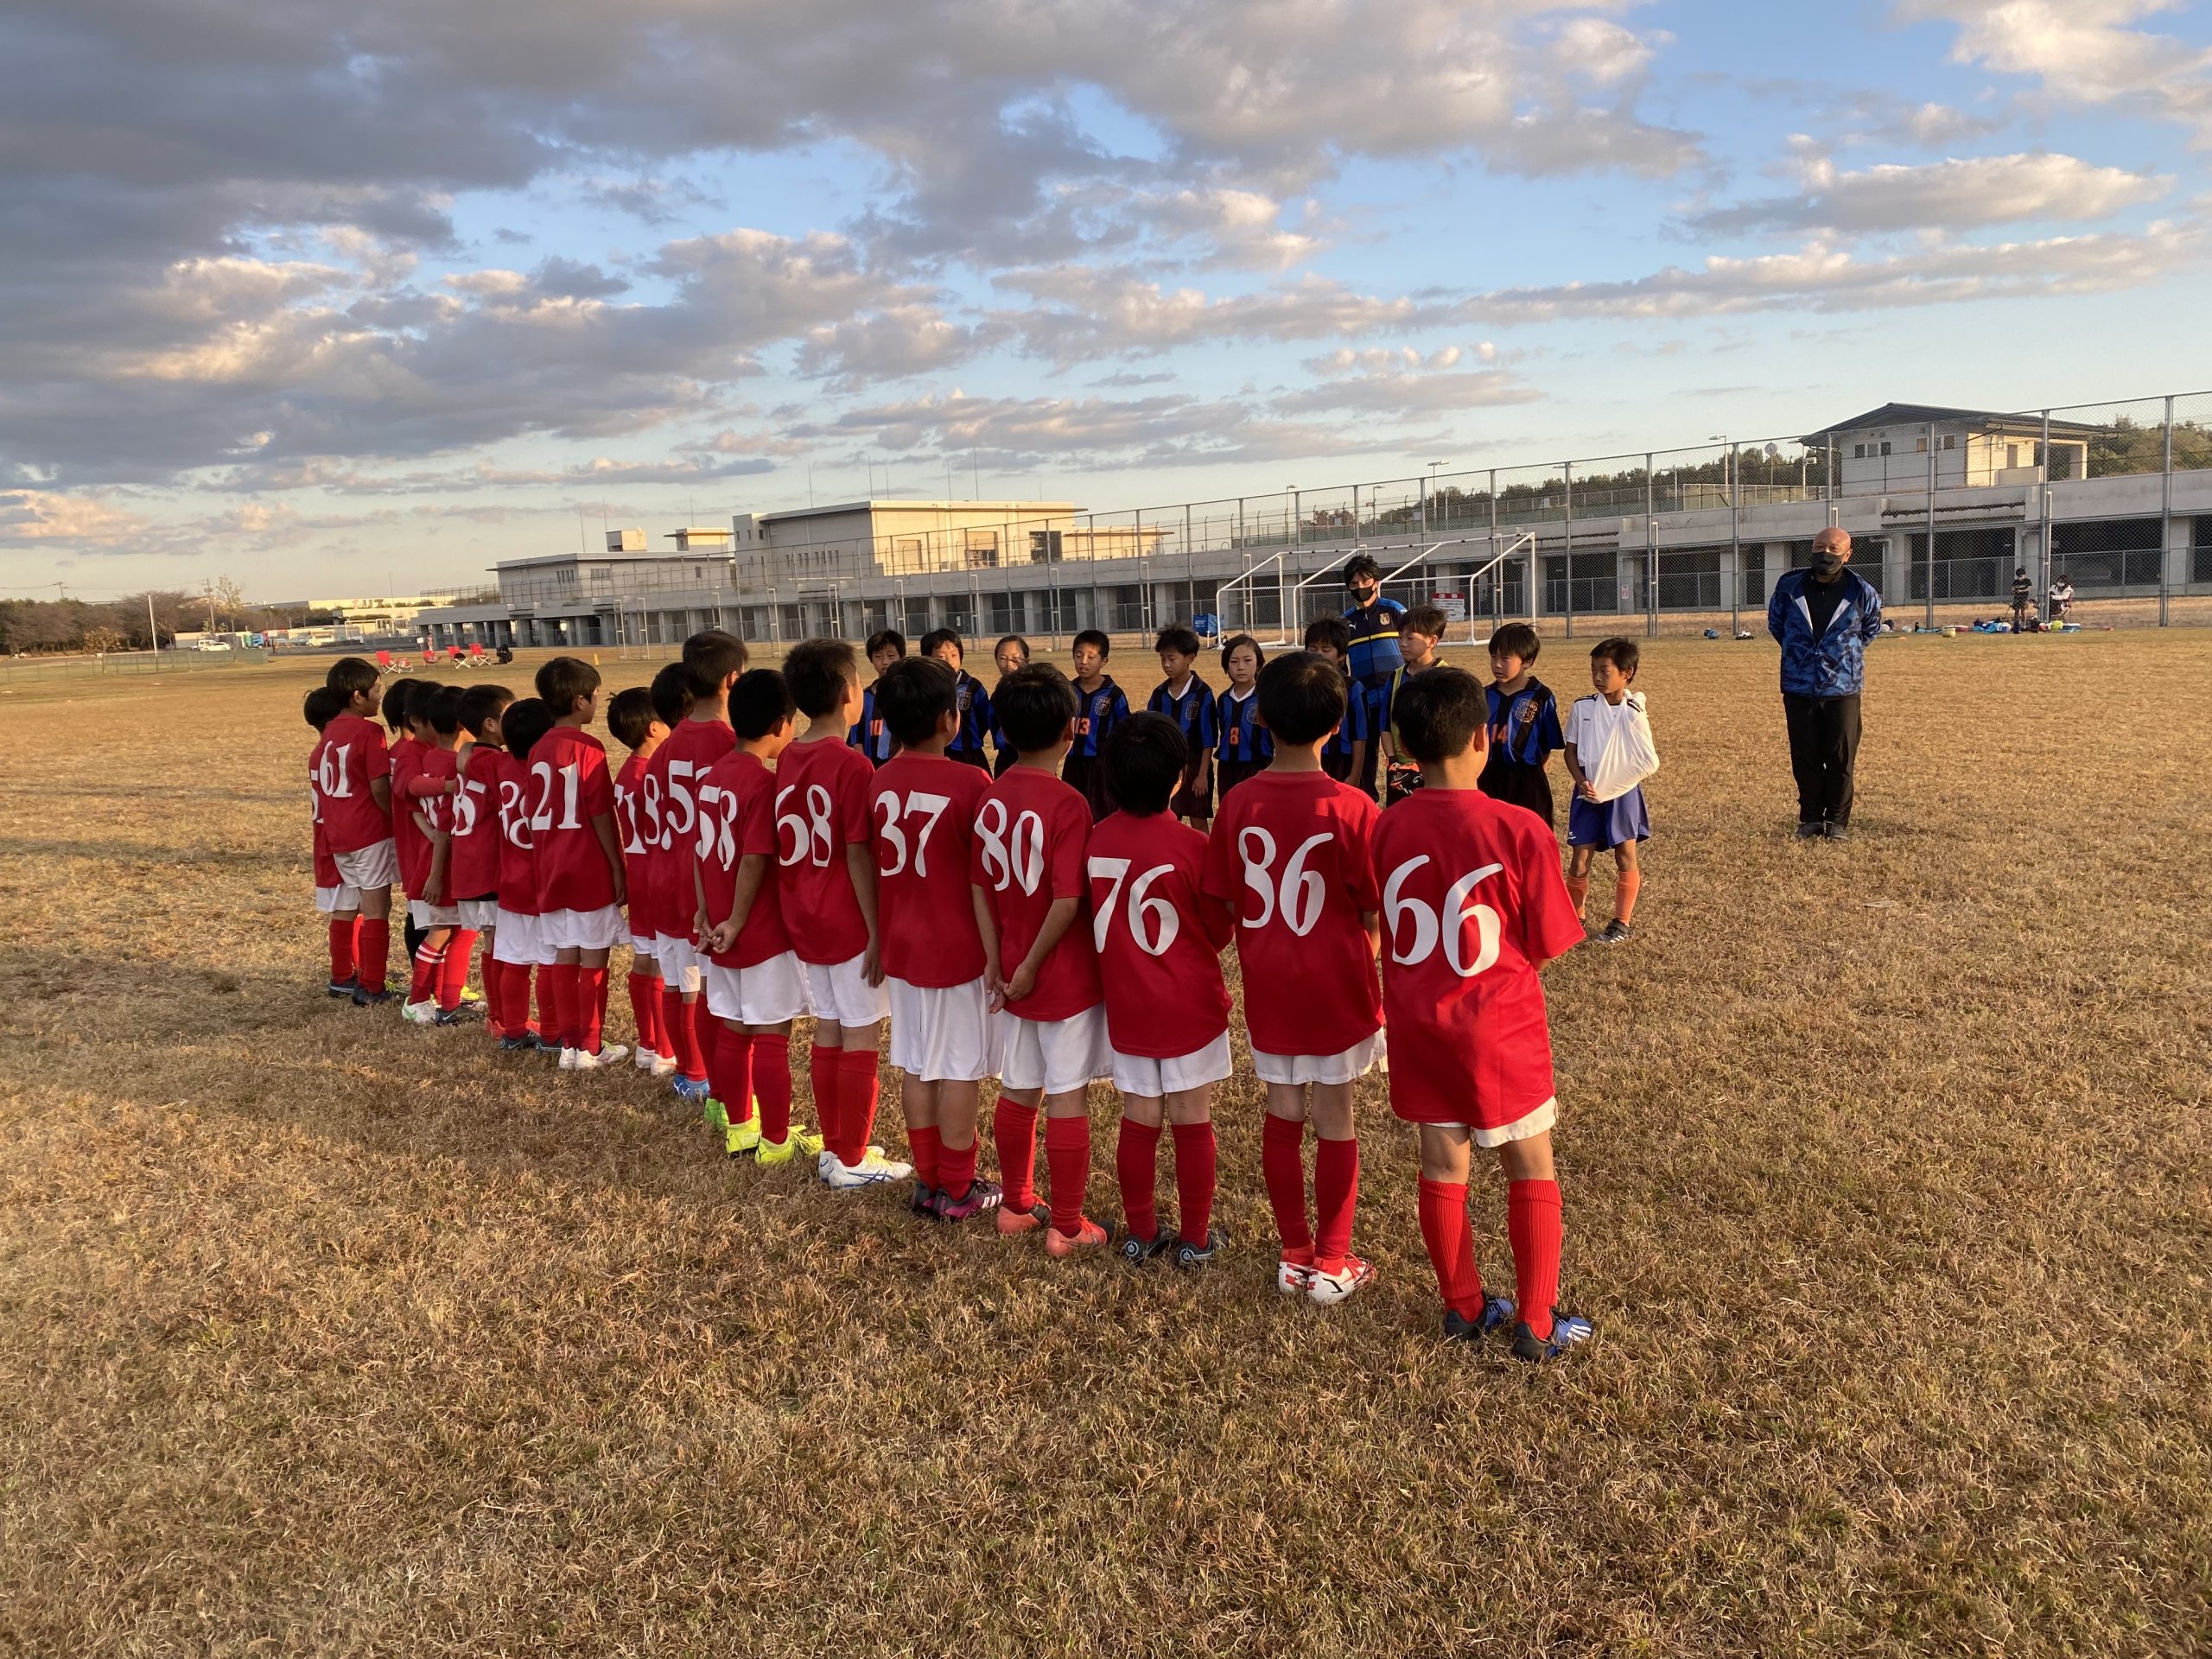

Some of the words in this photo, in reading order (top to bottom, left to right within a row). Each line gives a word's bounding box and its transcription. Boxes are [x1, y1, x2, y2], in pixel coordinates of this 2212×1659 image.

[319, 741, 353, 798] 61
[869, 719, 883, 736] 10
[1230, 727, 1239, 745] 8
[1491, 723, 1508, 744] 14
[531, 761, 582, 830] 21
[695, 785, 738, 872] 58
[775, 784, 832, 868] 68
[874, 790, 950, 878] 37
[974, 798, 1045, 897] 80
[1238, 826, 1334, 937] 86
[1087, 855, 1179, 956] 76
[1383, 855, 1503, 977] 66
